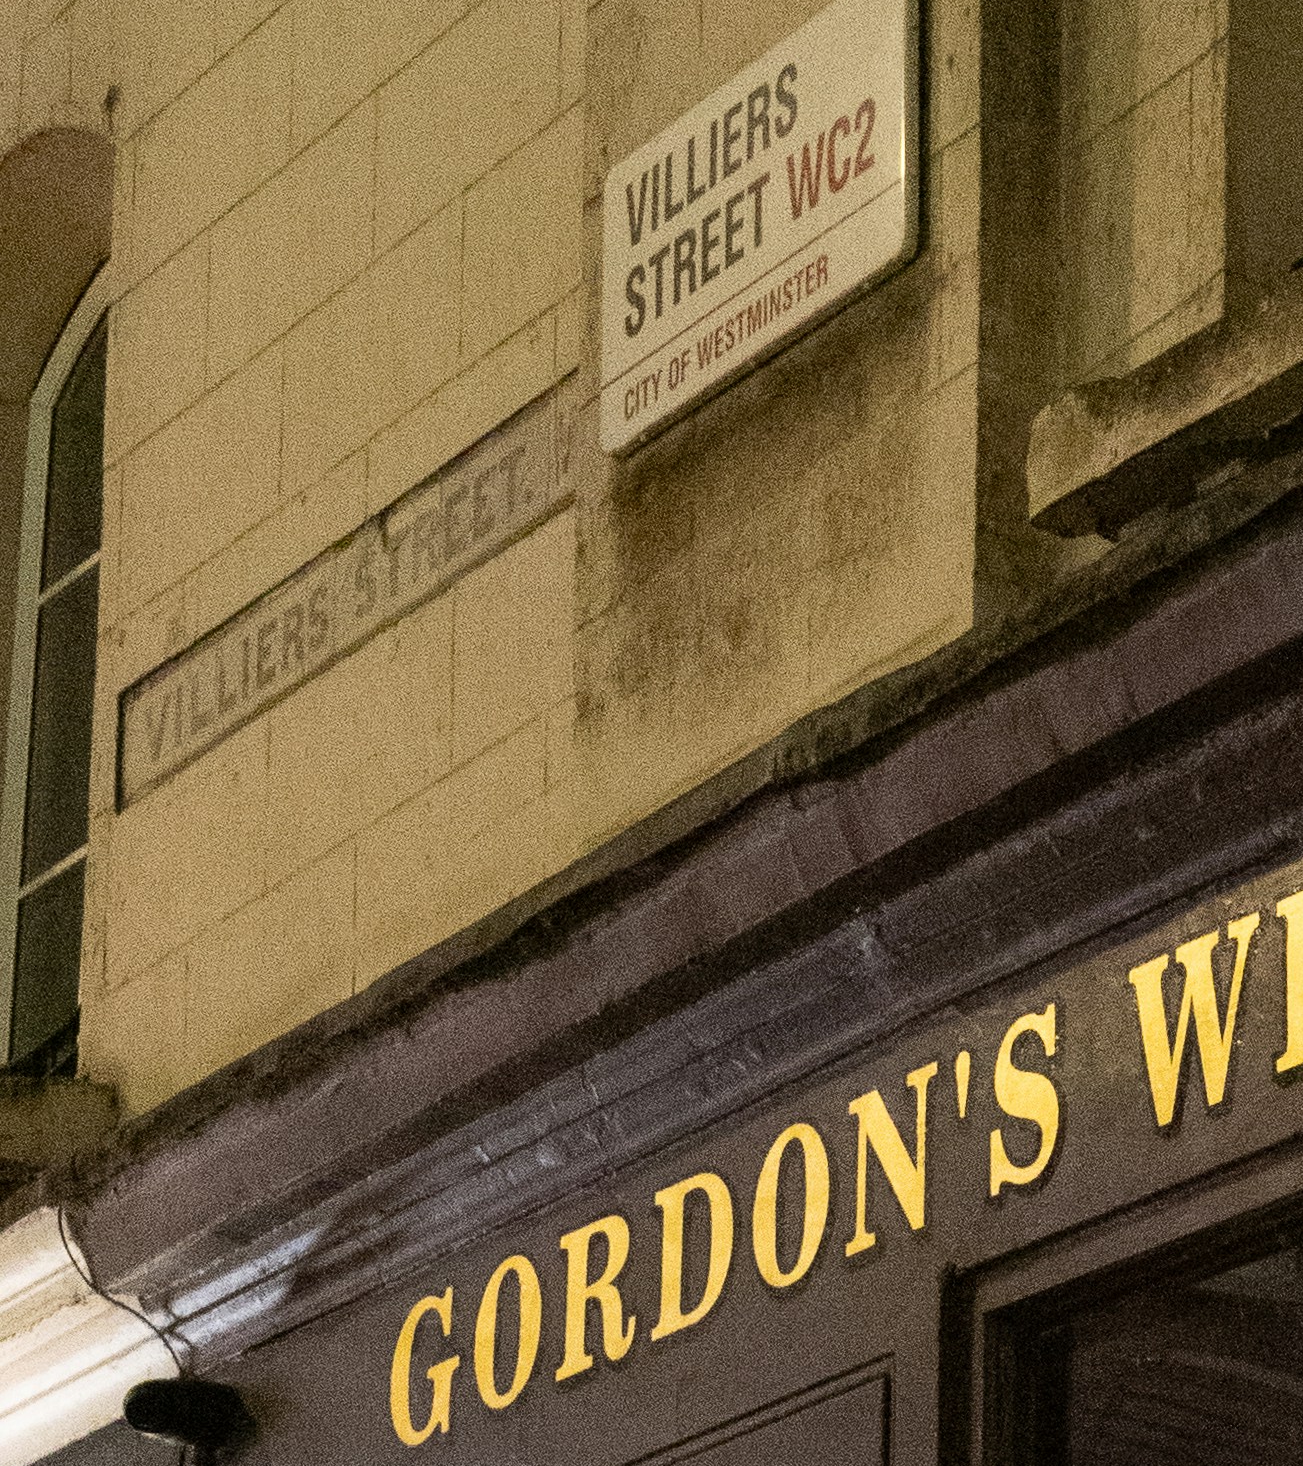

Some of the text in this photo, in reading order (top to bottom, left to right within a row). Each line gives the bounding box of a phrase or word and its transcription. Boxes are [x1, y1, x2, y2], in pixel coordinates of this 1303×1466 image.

[624, 96, 877, 338] STREET WC2
[626, 63, 798, 247] VILLIERS
[624, 254, 829, 421] CITY OF WESTMINSTER
[145, 586, 330, 762] VILLIERS
[389, 1002, 1062, 1447] GORDON'S
